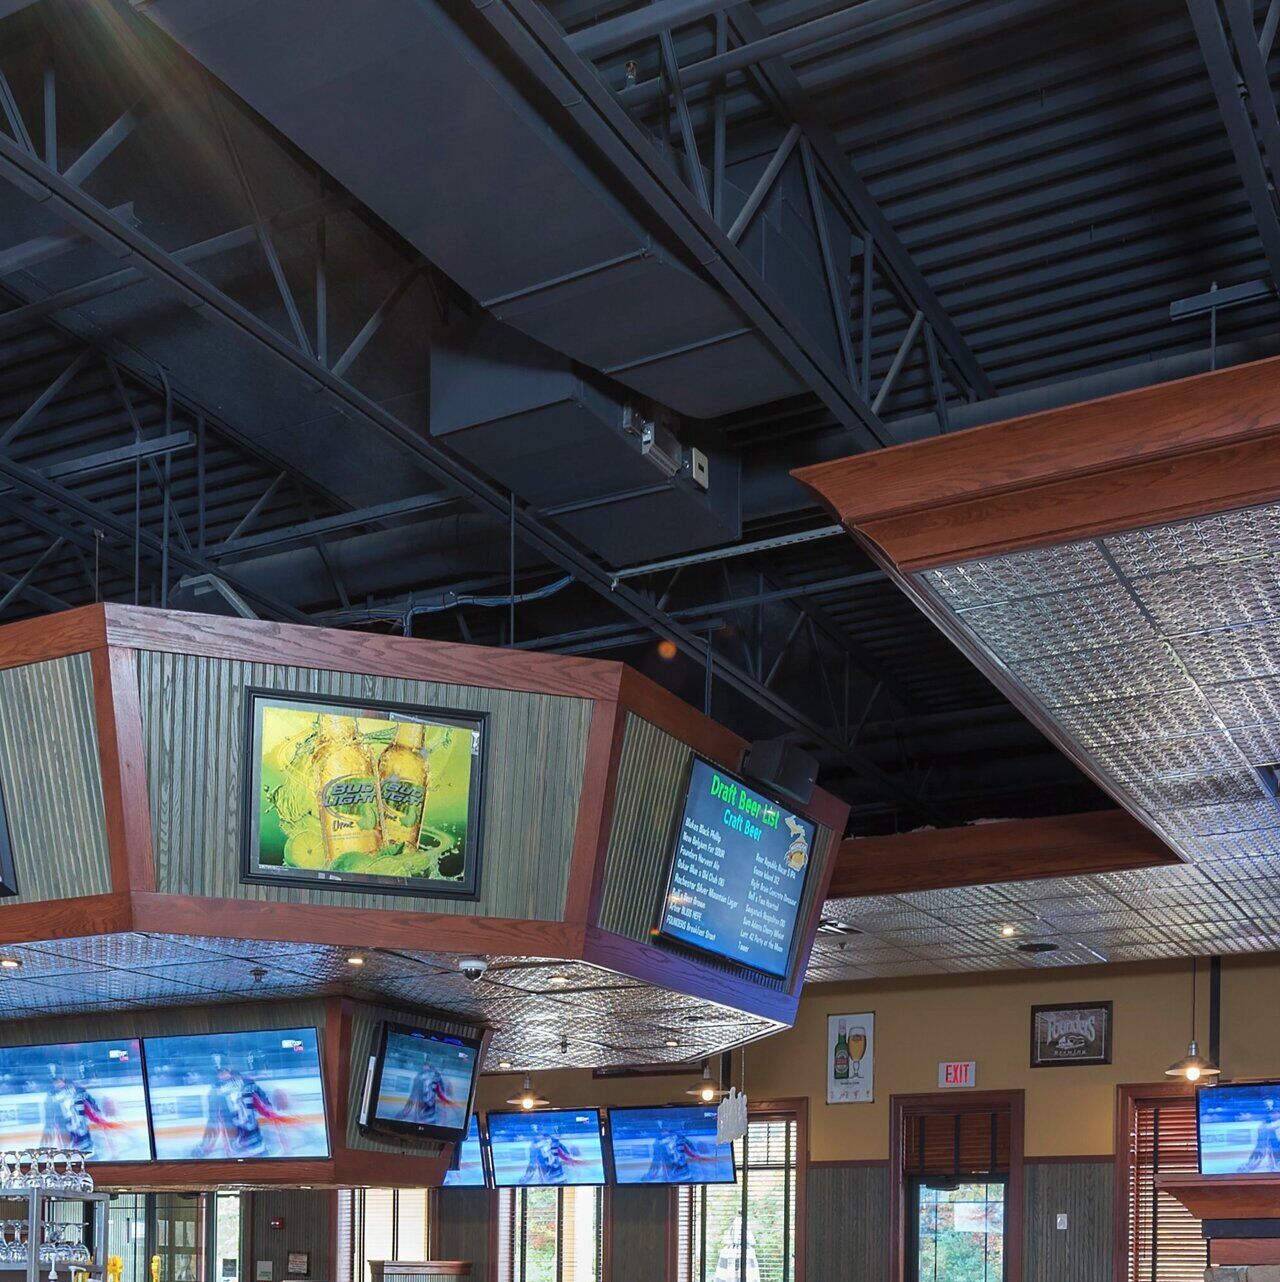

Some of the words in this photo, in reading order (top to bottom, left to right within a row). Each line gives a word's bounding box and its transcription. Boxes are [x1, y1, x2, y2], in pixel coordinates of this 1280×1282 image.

[332, 784, 374, 795] BUD
[387, 783, 423, 797] BUD
[324, 793, 376, 807] LIGHT
[710, 775, 737, 806] Draft
[738, 790, 761, 819] Beer
[762, 804, 780, 829] List
[723, 809, 743, 831] Craft
[744, 820, 763, 841] Beer
[945, 1063, 970, 1083] EXIT
